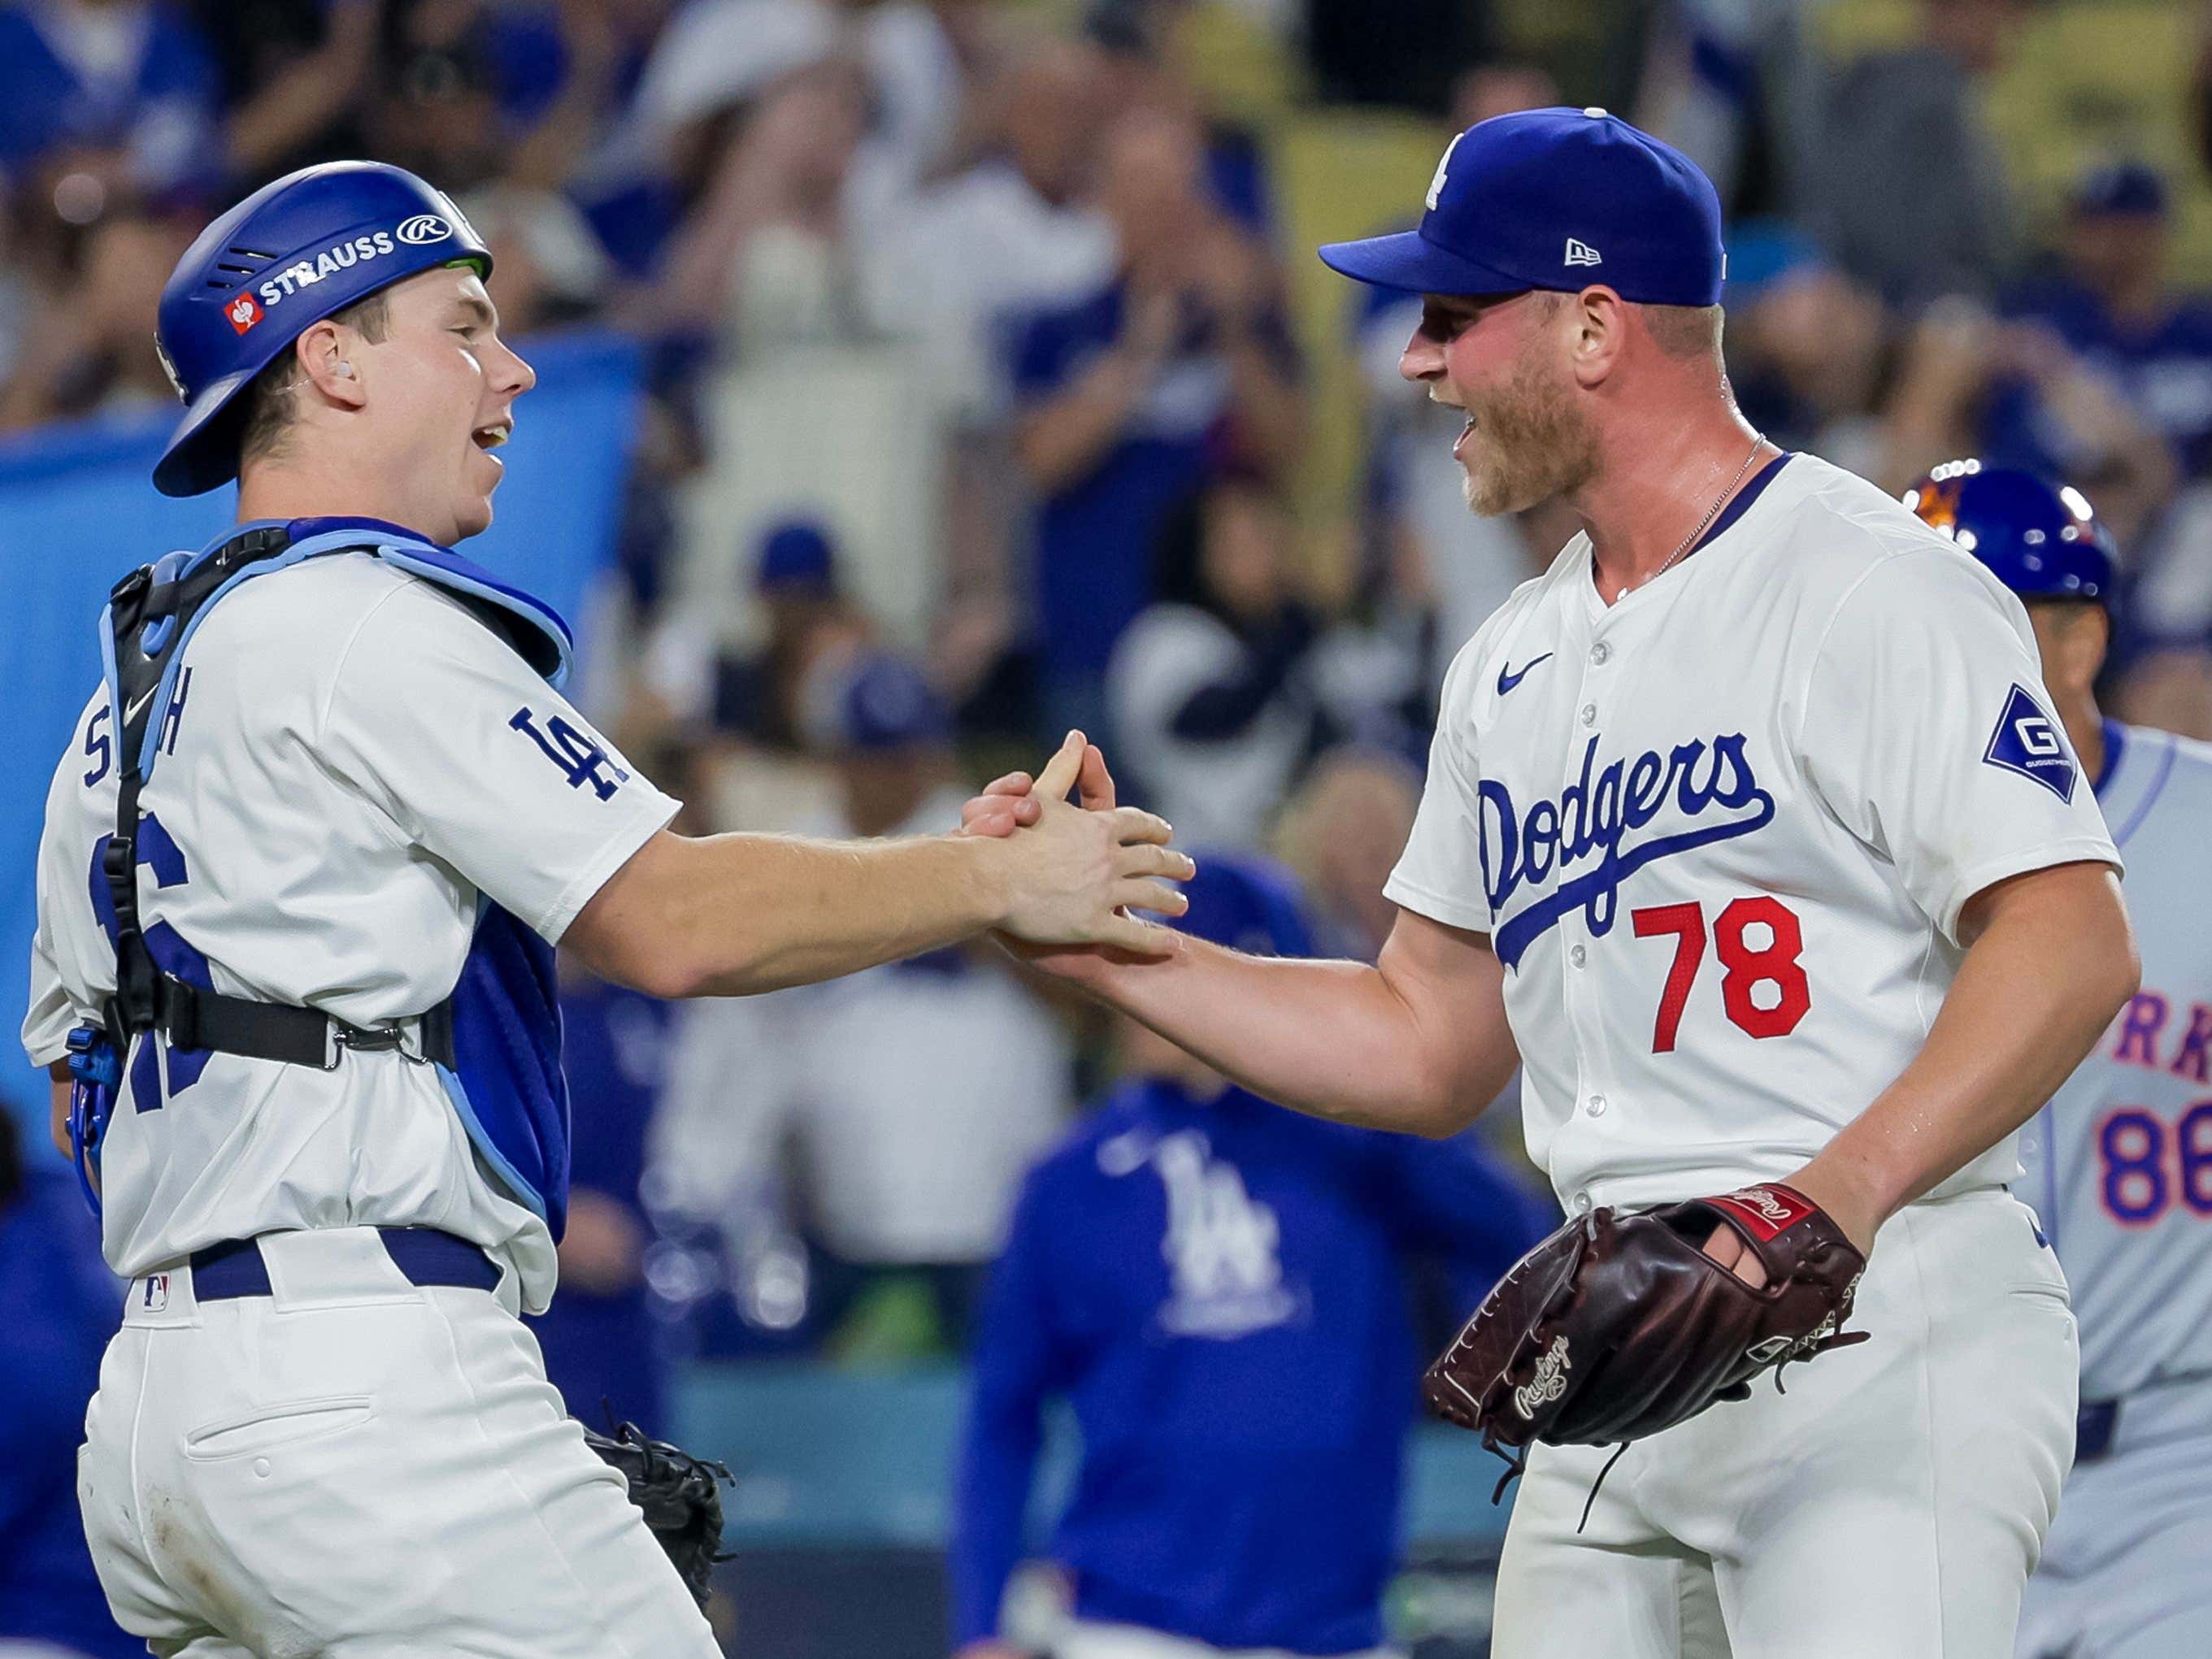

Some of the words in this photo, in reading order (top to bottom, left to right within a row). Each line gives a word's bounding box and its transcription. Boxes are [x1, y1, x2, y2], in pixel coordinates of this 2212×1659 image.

[259, 232, 394, 306] STRAUSS
[508, 706, 629, 802] LA
[2015, 717, 2060, 755] G
[1478, 732, 1775, 959] Dodgers
[1631, 896, 1811, 1054] 78
